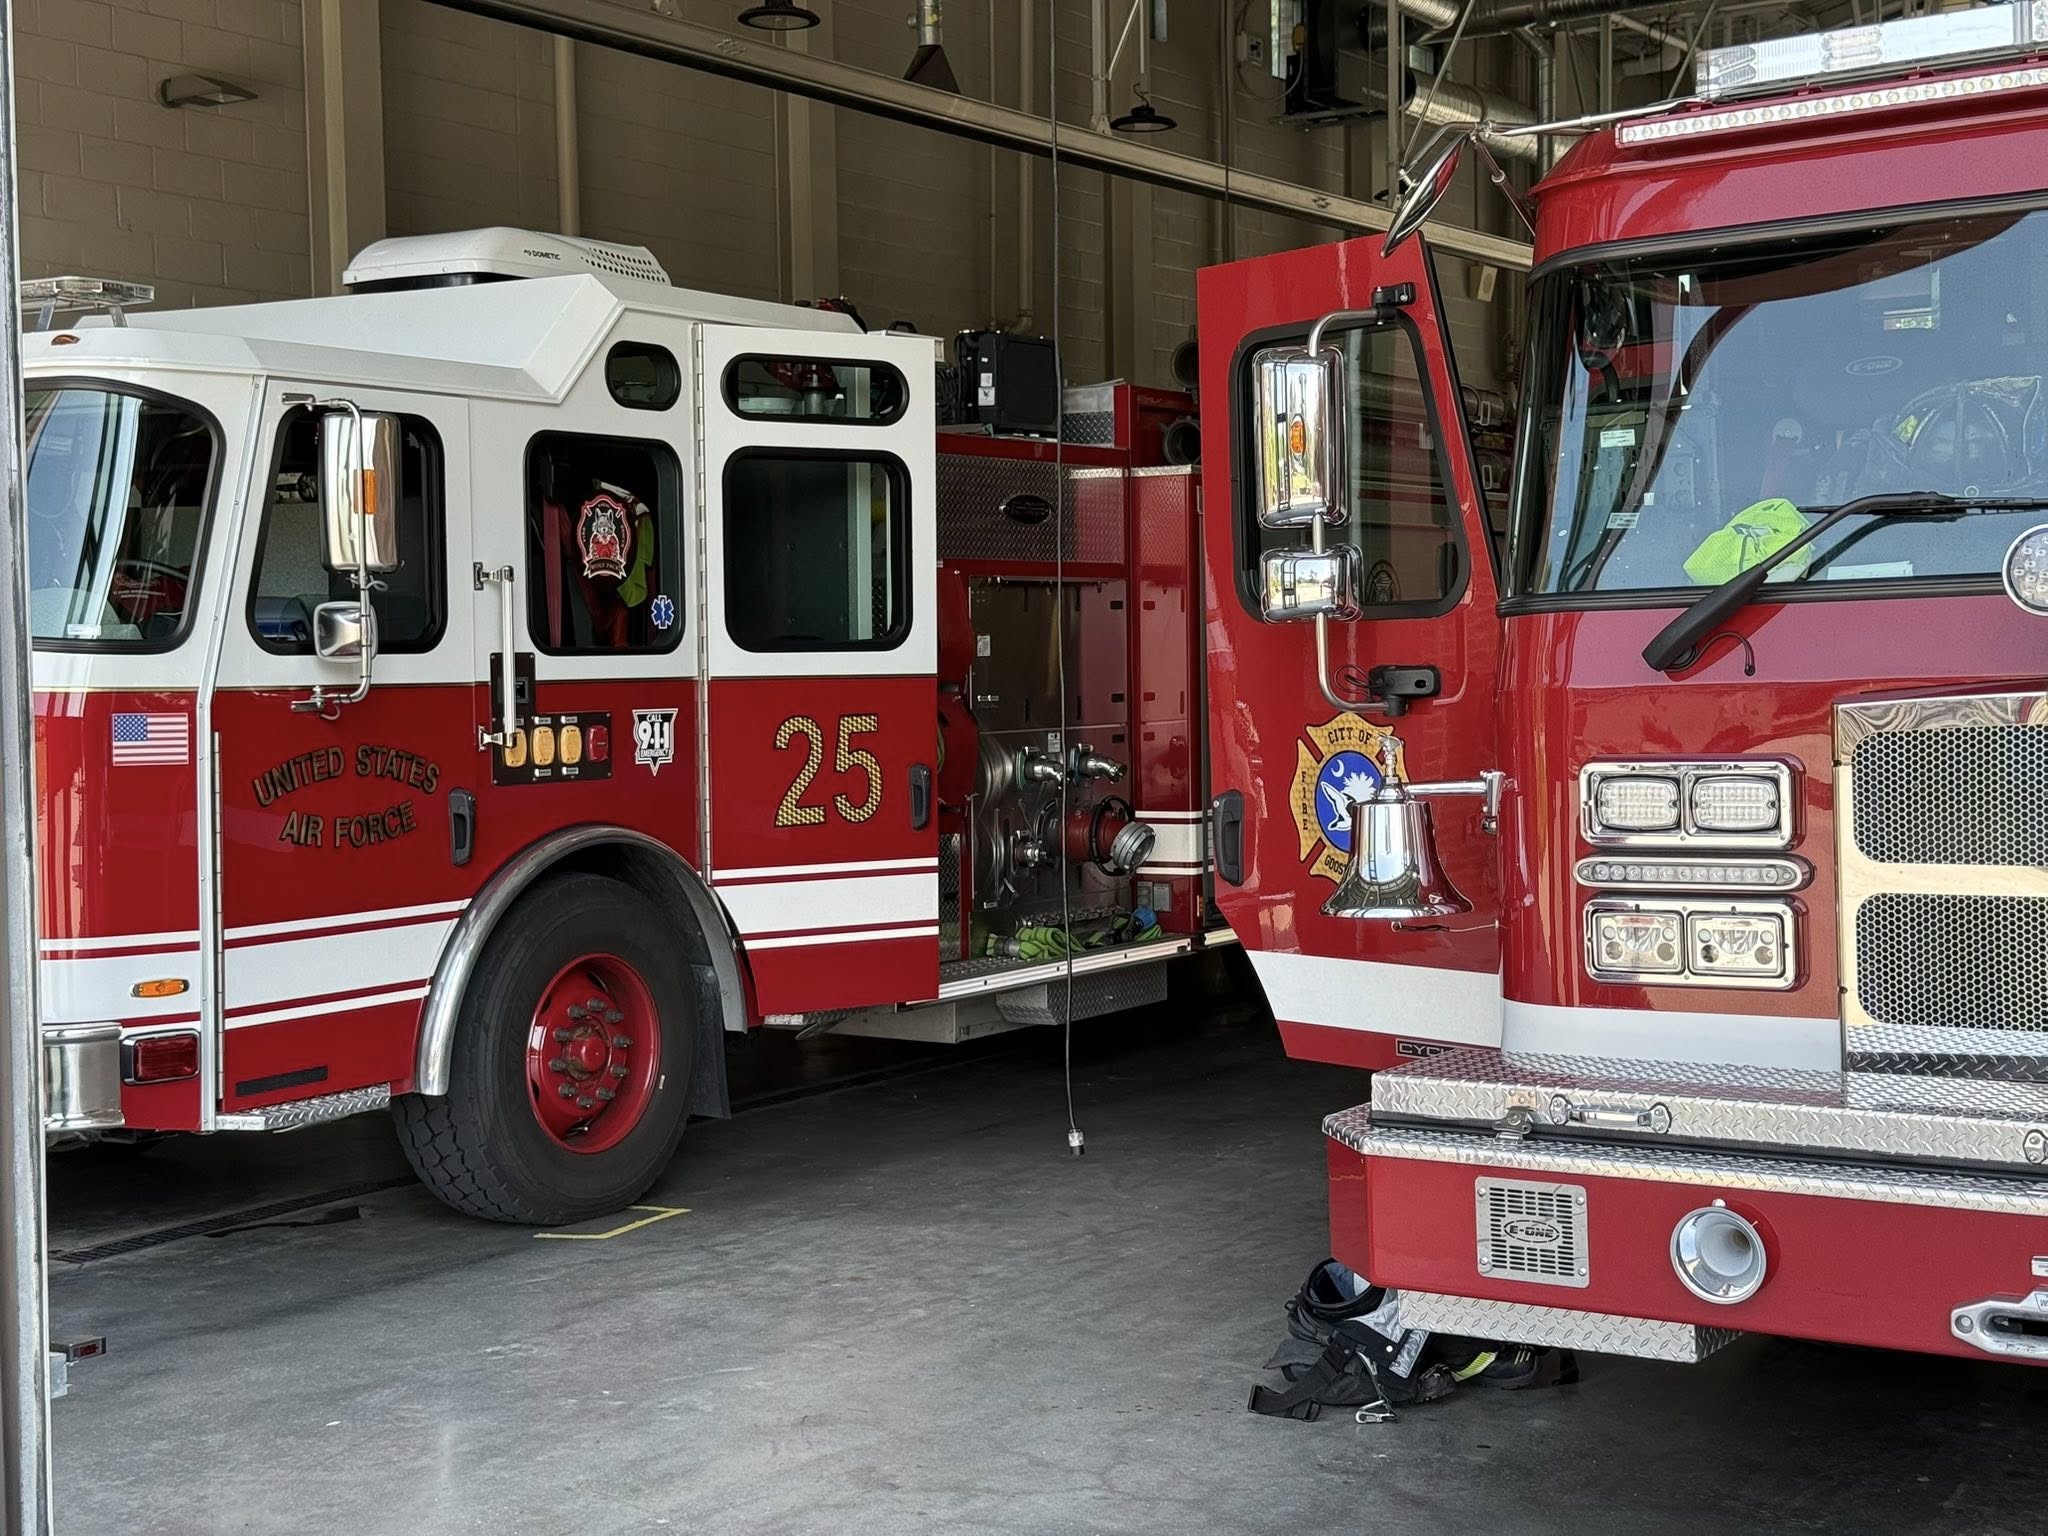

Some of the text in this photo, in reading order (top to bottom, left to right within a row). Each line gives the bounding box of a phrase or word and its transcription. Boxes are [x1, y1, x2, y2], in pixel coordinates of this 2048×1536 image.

[531, 249, 561, 260] DOMETIC
[646, 713, 663, 722] CALL
[1327, 726, 1373, 745] CITY OF
[253, 743, 441, 807] UNITED STATES
[774, 713, 883, 827] 25
[1301, 771, 1309, 831] FIRE
[279, 800, 417, 848] AIR FORCE
[1509, 1225, 1554, 1238] E-ONE
